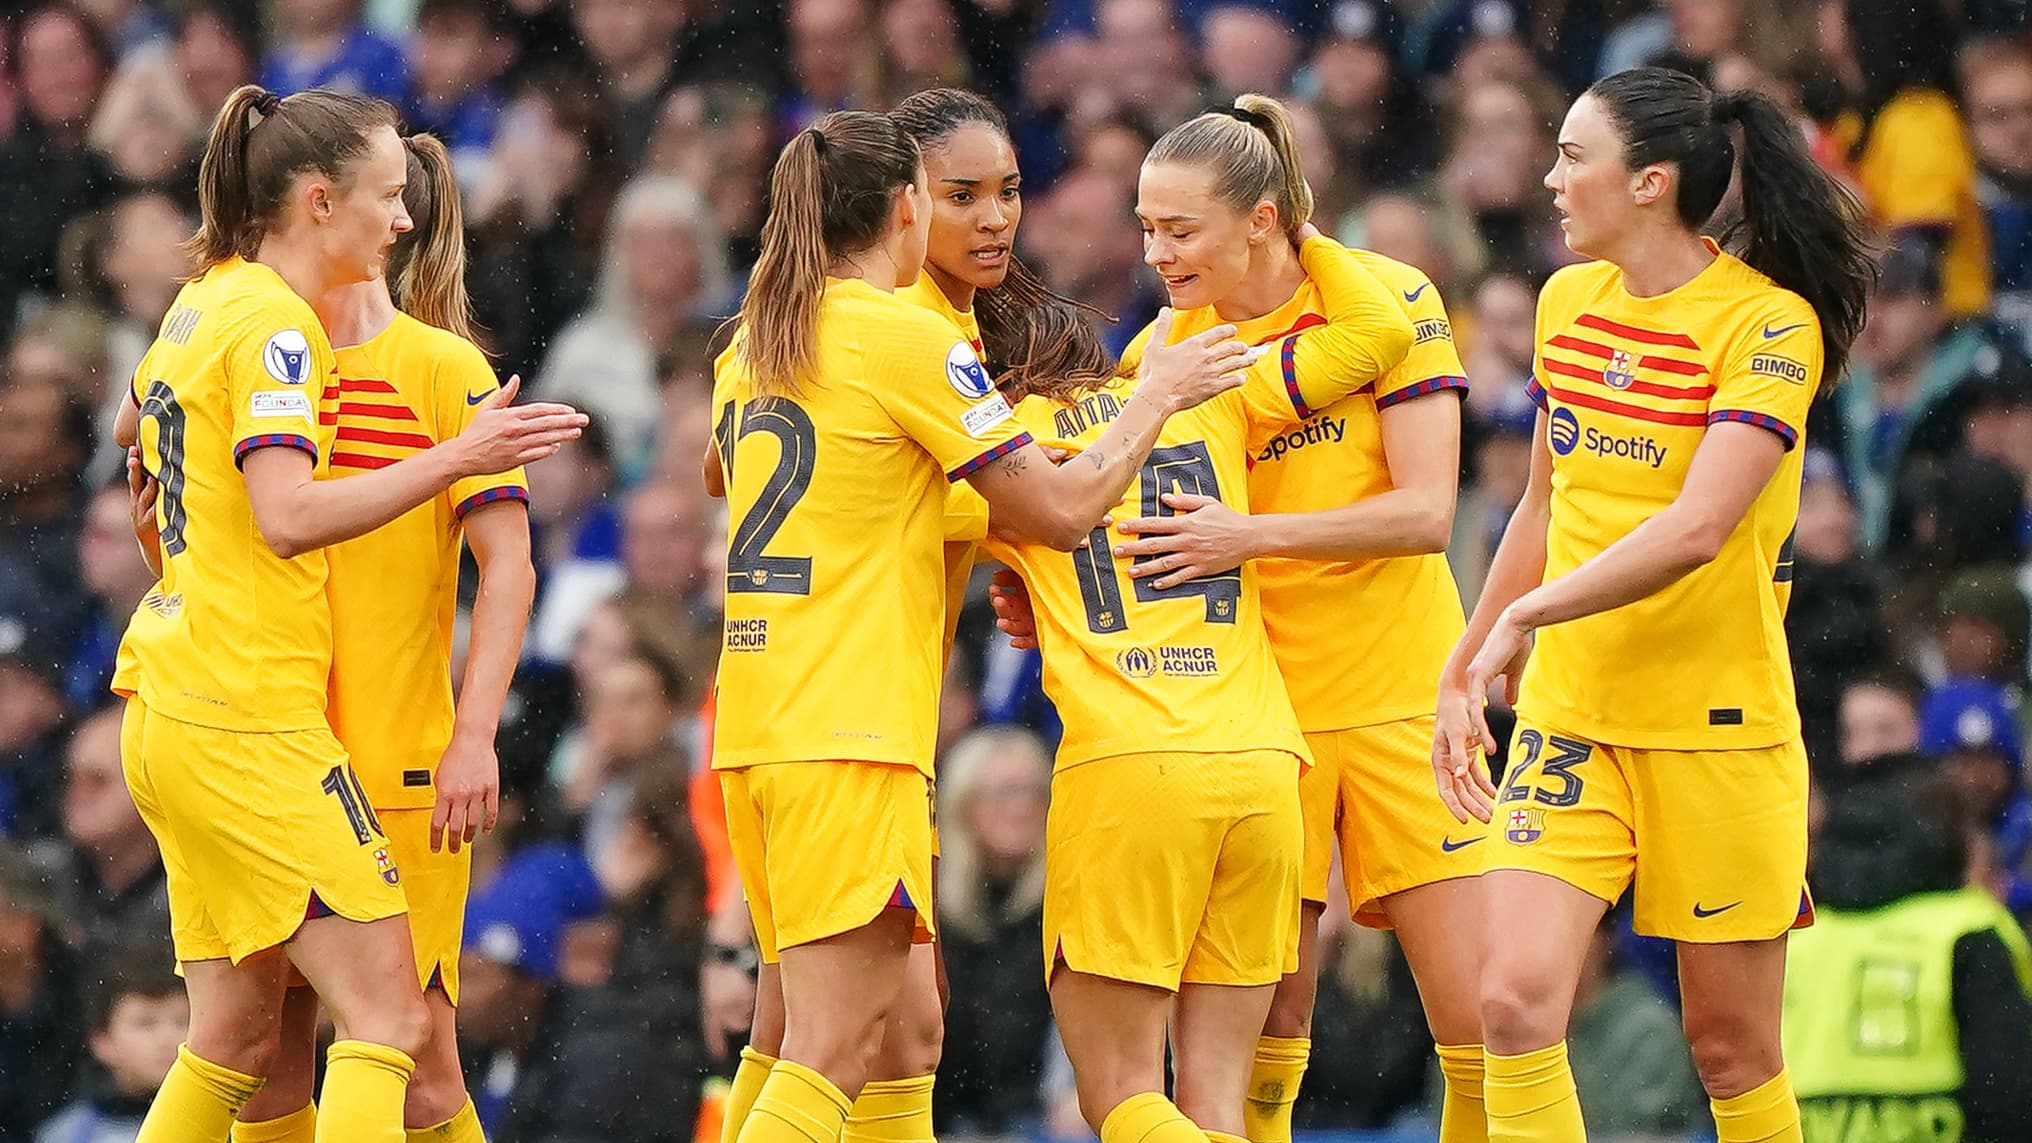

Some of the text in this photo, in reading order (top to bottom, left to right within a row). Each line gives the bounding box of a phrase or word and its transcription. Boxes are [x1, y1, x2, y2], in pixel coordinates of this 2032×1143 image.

[1751, 357, 1807, 382] BIMBO
[1053, 393, 1130, 439] AITA
[1584, 427, 1668, 469] Spotify
[727, 619, 768, 633] UNHCR
[727, 633, 767, 647] ACNUR
[1159, 646, 1215, 660] UNHCR
[1162, 660, 1218, 673] ACNUR
[1499, 729, 1593, 807] 23
